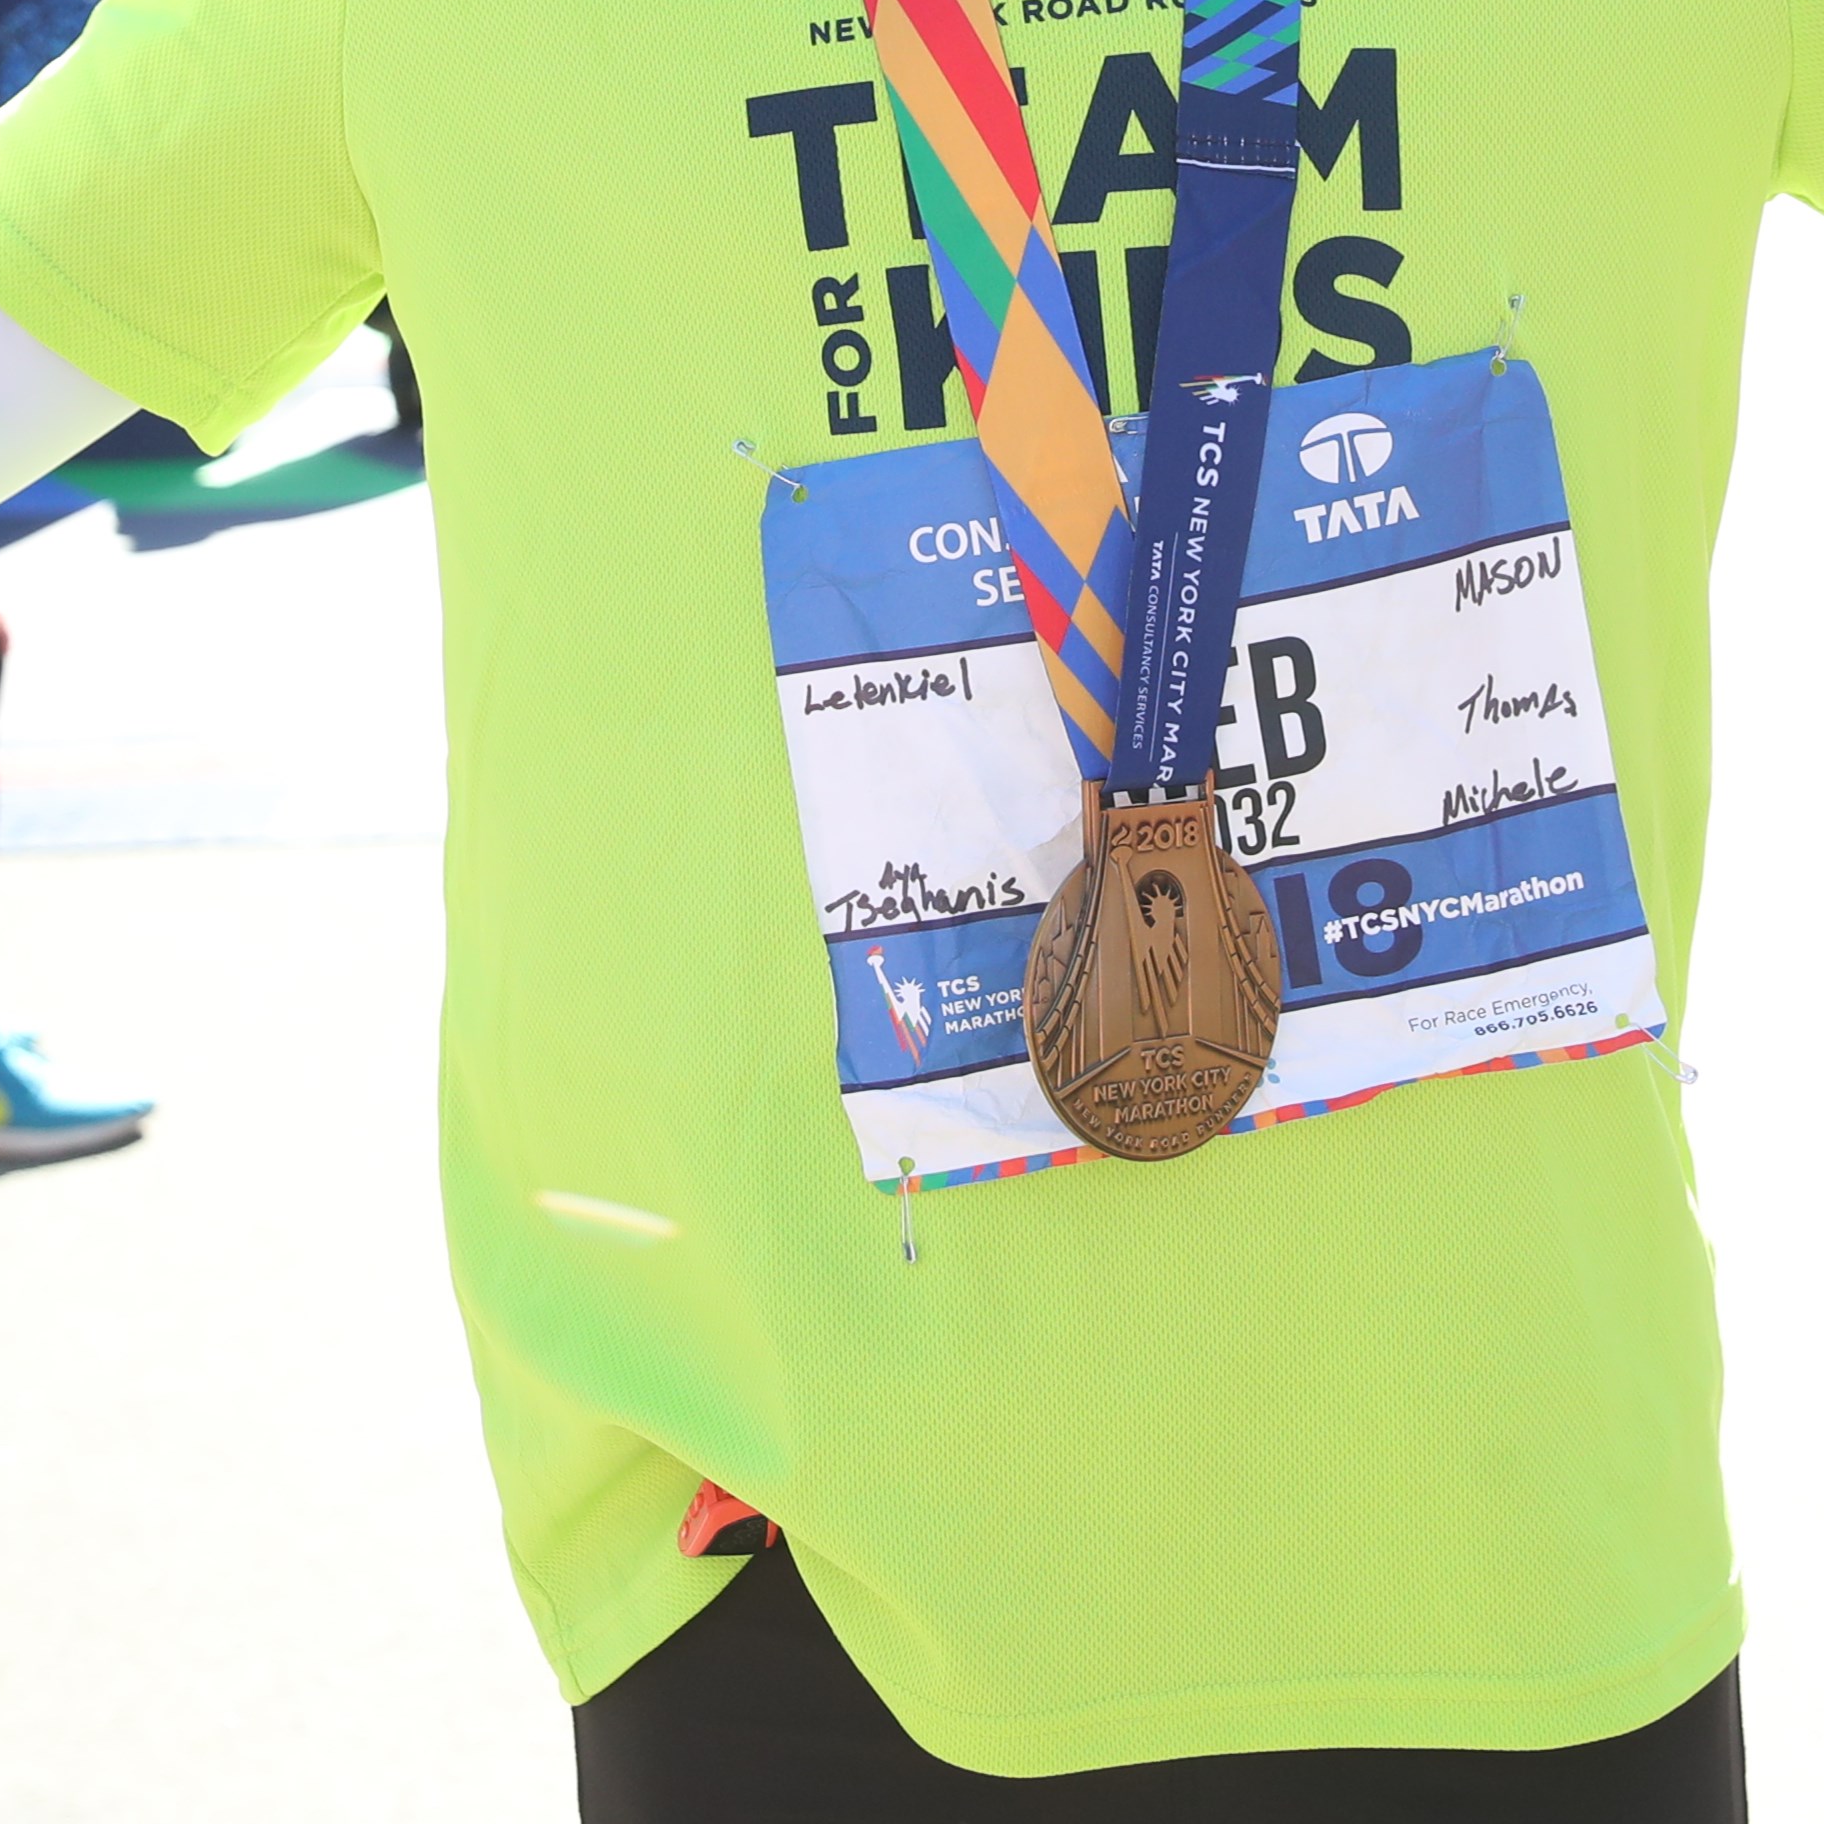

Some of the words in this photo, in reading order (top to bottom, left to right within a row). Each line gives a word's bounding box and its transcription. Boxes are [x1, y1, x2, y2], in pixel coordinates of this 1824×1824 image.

[746, 48, 1402, 252] TAM
[811, 272, 878, 436] FOR
[1195, 422, 1226, 487] TCS
[1184, 496, 1210, 563] NEW
[1293, 485, 1420, 544] TATA
[1149, 540, 1164, 581] TATA
[1455, 536, 1562, 613] MASON
[1139, 585, 1160, 685] CONSULTANCY
[1175, 569, 1202, 644] YORK
[1167, 650, 1189, 716] CITY
[1132, 687, 1149, 750] SERVICES
[1442, 756, 1580, 826] Michele
[1136, 820, 1202, 854] 2018
[1273, 857, 1425, 991] 18
[1322, 869, 1587, 946] #TCSNYCMarathon
[937, 975, 981, 998] TCS
[941, 996, 982, 1017] NEW
[985, 987, 1025, 1007] YOR
[1407, 1014, 1439, 1033] For
[1444, 1005, 1487, 1027] Race
[1491, 980, 1594, 1016] Emergency,
[1473, 1000, 1600, 1037] 866.705.6626
[1093, 1080, 1137, 1104] NEW
[1141, 1073, 1189, 1096] YORK
[1191, 1065, 1233, 1088] CITY
[1140, 1045, 1185, 1072] TCS
[1106, 1126, 1144, 1149] YORK
[1149, 1132, 1190, 1151] ROAD
[1114, 1092, 1215, 1125] MARATHON
